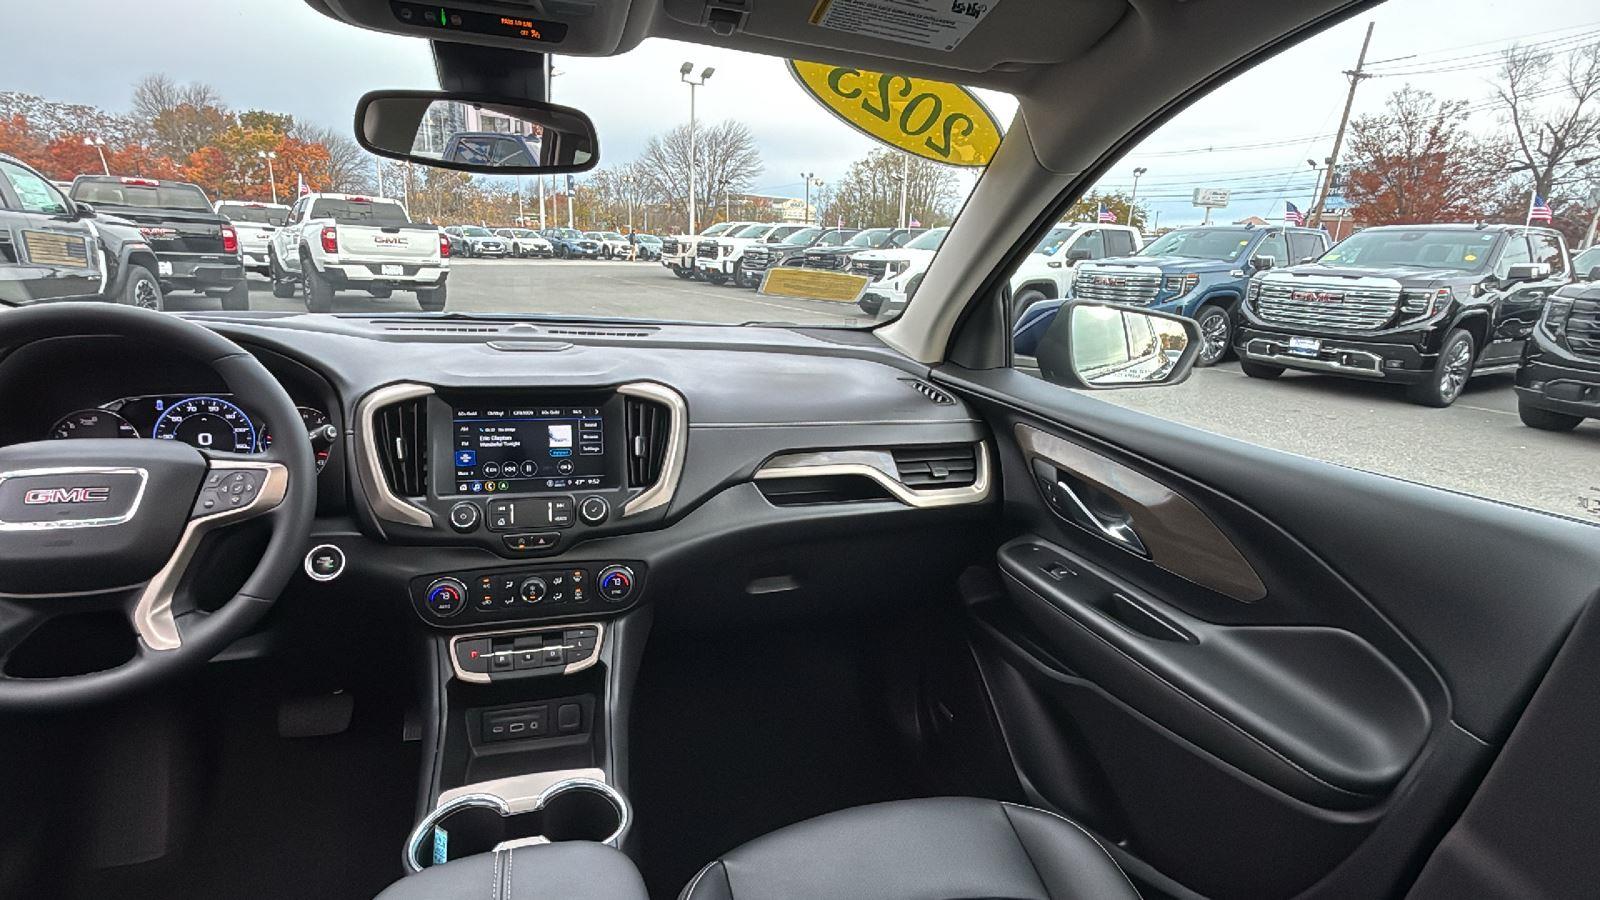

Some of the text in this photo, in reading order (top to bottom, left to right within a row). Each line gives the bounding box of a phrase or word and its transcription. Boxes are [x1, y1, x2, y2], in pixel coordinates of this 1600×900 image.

[374, 236, 408, 245] GMC
[198, 433, 212, 445] 0
[24, 486, 110, 505] GMC
